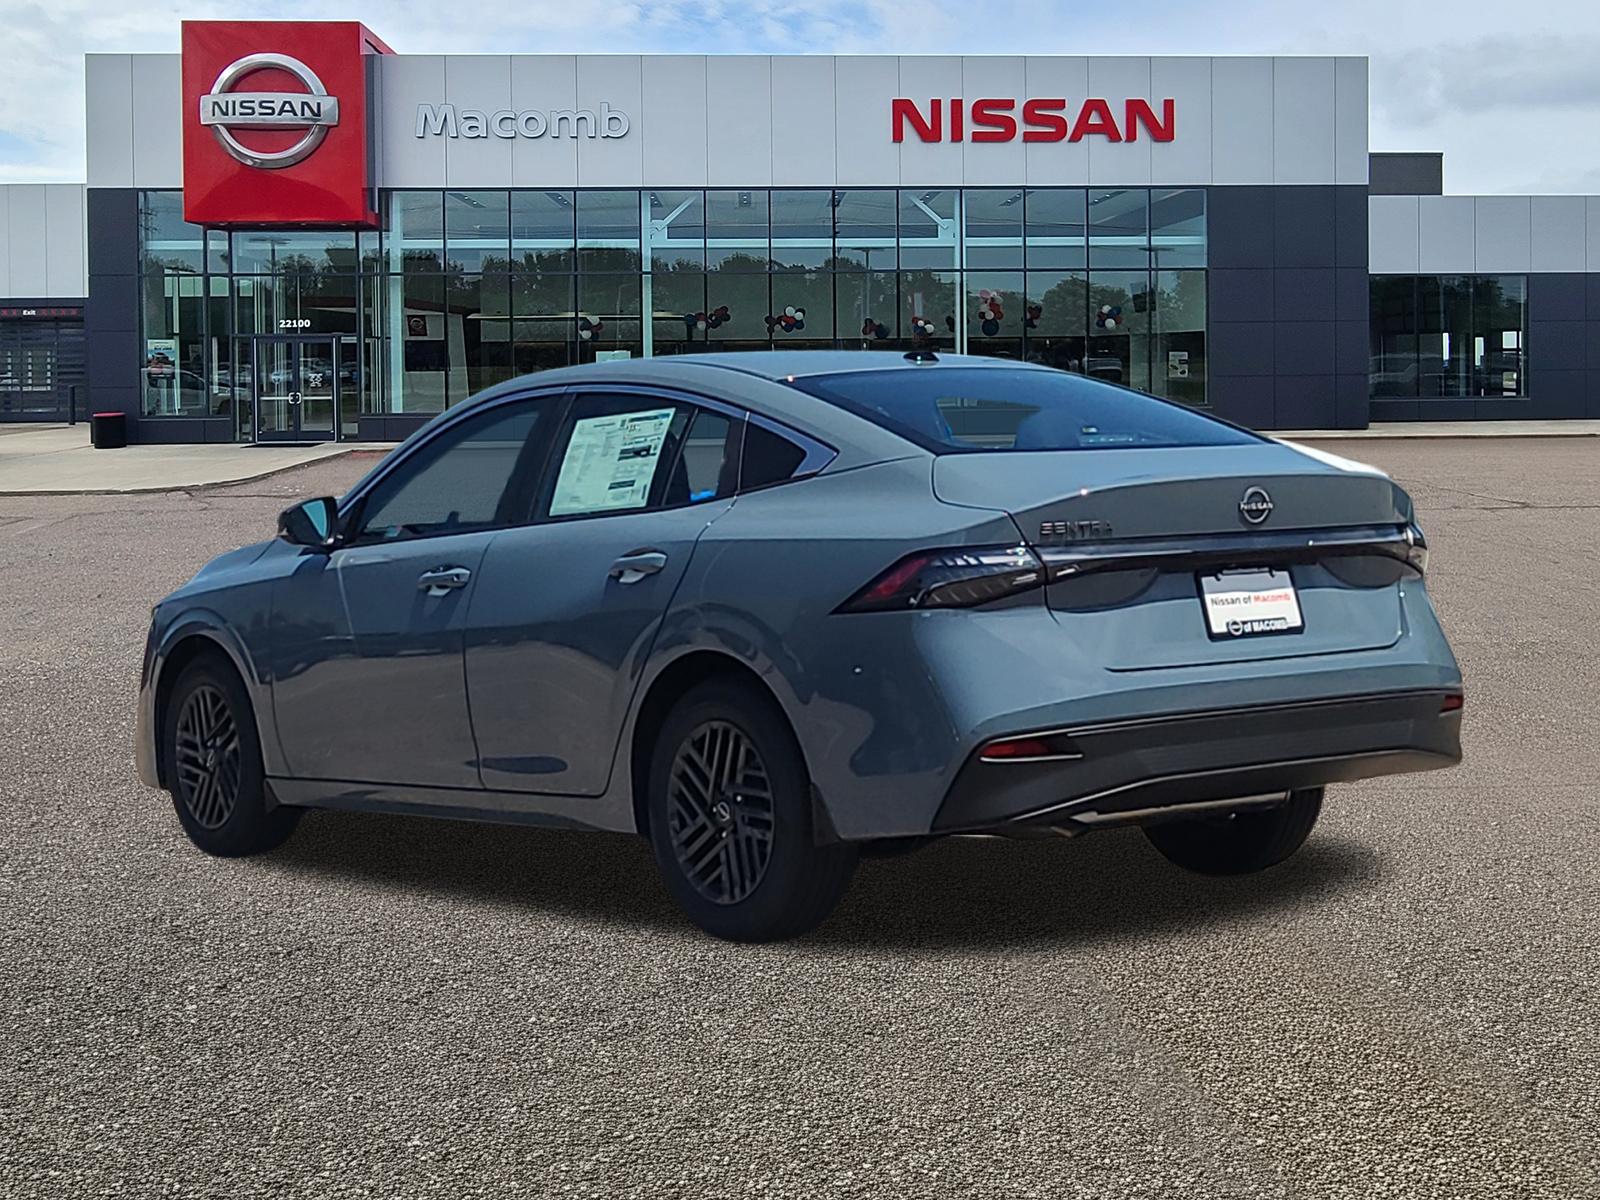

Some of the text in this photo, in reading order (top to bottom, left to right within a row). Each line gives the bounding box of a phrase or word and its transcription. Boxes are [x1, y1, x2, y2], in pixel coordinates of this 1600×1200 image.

[212, 100, 322, 118] NISSAN
[415, 102, 630, 139] Macomb
[892, 98, 1175, 143] NISSAN
[279, 319, 311, 328] 22100
[1240, 502, 1273, 510] NISSAN
[1040, 521, 1112, 538] SENTRA
[1211, 592, 1291, 606] Nissan of Macomb
